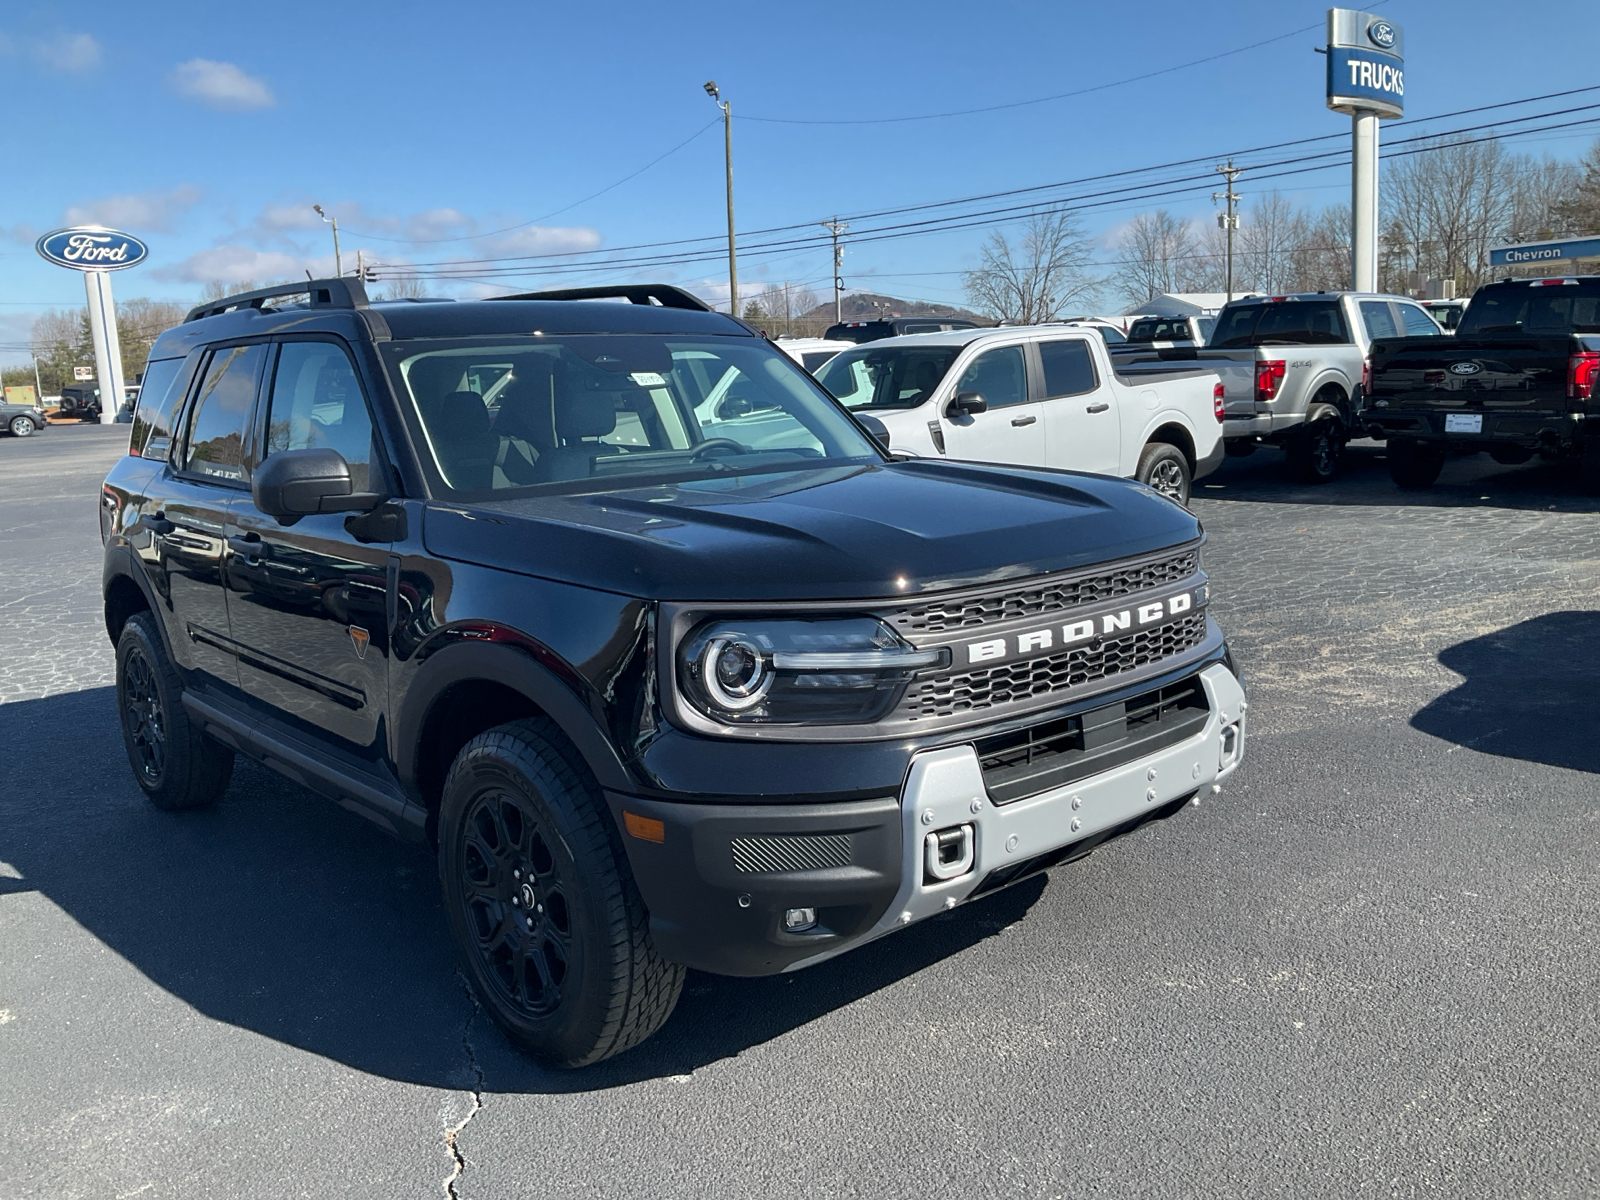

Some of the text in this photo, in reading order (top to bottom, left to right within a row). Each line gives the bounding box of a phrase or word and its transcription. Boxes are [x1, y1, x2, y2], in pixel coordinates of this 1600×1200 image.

[1378, 25, 1394, 43] Ford
[1347, 60, 1404, 96] TRUCKS
[63, 234, 128, 261] Ford
[1505, 248, 1561, 262] Chevron
[968, 593, 1191, 663] BRONCO
